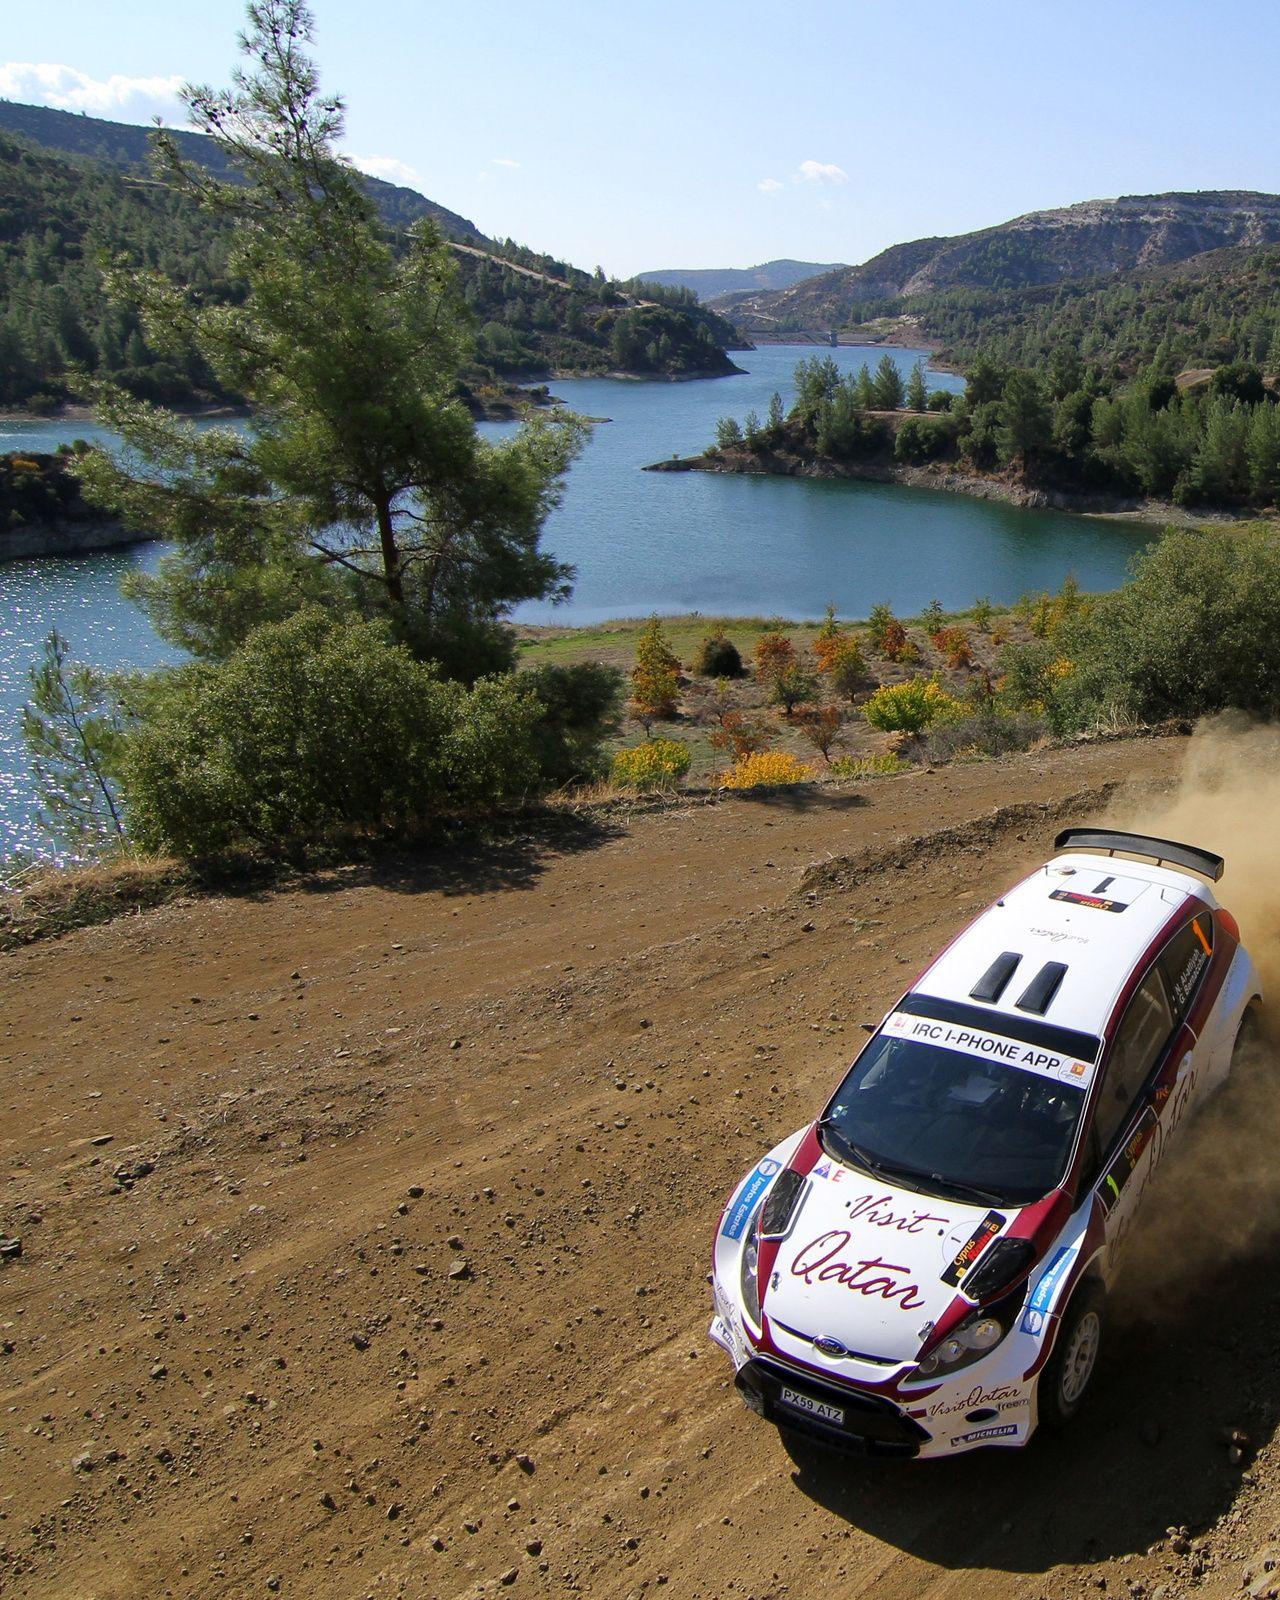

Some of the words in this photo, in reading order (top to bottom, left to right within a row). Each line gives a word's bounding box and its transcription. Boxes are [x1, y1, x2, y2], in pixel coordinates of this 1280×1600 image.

[1091, 877, 1116, 894] 1
[912, 1023, 942, 1039] IRC
[945, 1029, 1020, 1060] I-PHONE
[1021, 1051, 1061, 1071] APP
[744, 1176, 766, 1203] Leptos
[832, 1170, 846, 1183] E
[728, 1203, 748, 1236] Estates
[850, 1195, 949, 1233] Visit
[953, 1239, 976, 1266] Cyprus
[791, 1230, 925, 1310] Qatar
[1033, 1276, 1053, 1307] Leptos
[784, 1389, 814, 1410] PX59
[817, 1405, 842, 1421] ATZ
[967, 1426, 1015, 1441] MICHELIN
